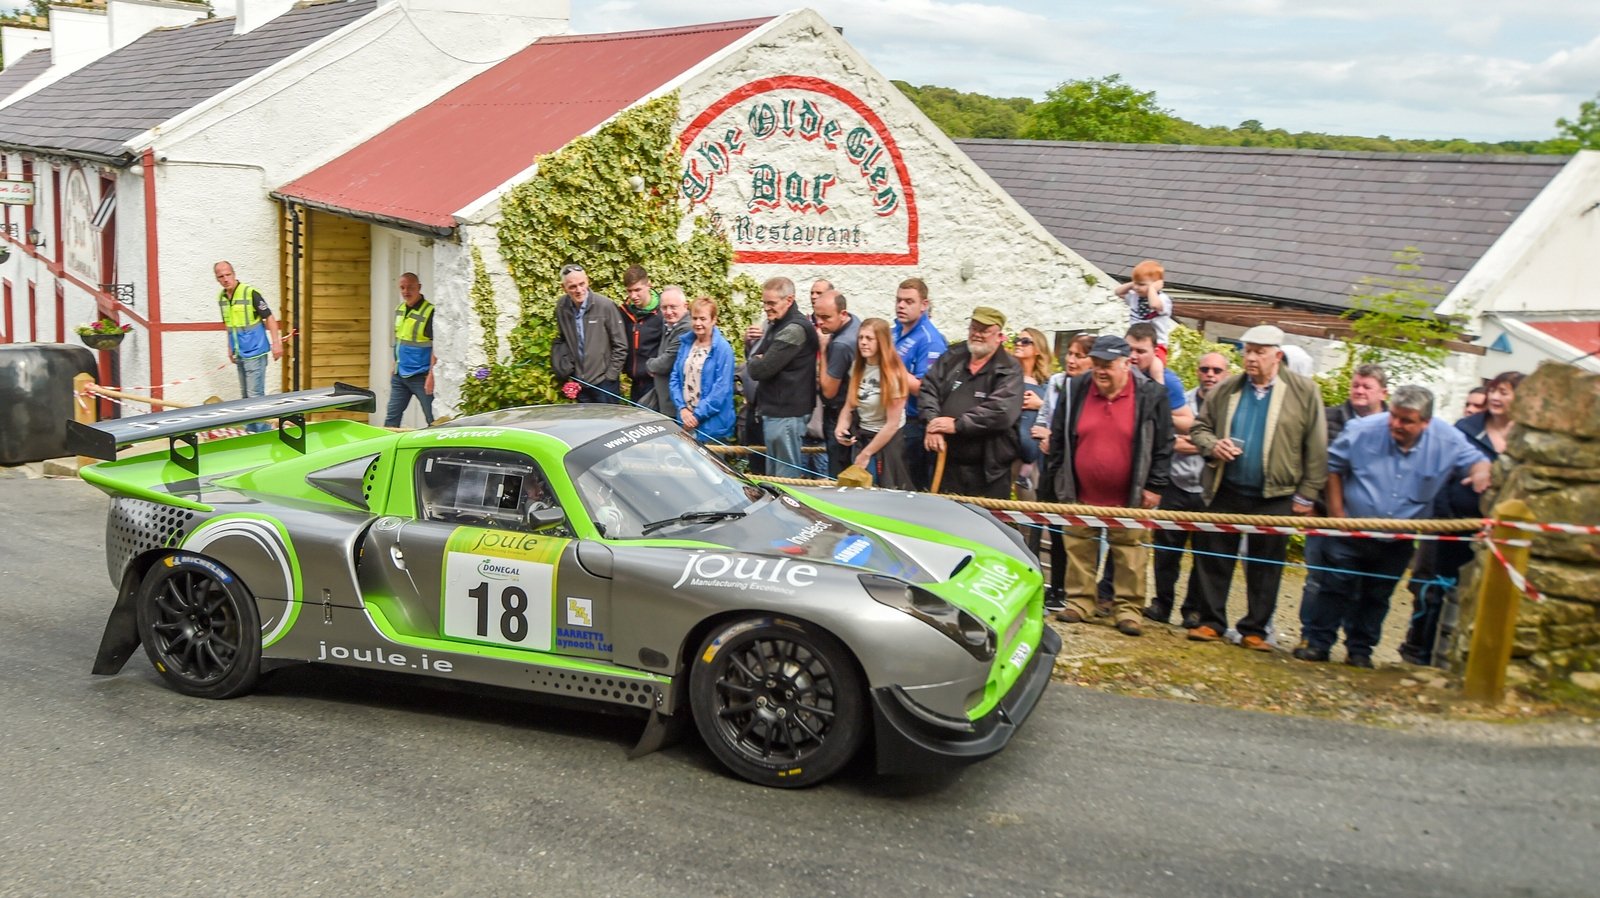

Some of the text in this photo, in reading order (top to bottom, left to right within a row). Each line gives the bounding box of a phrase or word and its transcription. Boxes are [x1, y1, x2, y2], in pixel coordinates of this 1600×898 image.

[681, 99, 899, 217] The Olde Glen
[748, 163, 836, 214] Bar
[604, 425, 666, 449] www.joule.ie
[472, 530, 538, 551] joule
[483, 564, 520, 575] DONEGAL
[673, 550, 817, 589] joule
[690, 578, 795, 596] Manufacturing Excellence
[956, 562, 1020, 614] joule
[468, 581, 528, 642] 18
[557, 628, 604, 641] BARRETTS
[557, 639, 613, 652] aynooth Ltd
[318, 641, 453, 672] joule.ie
